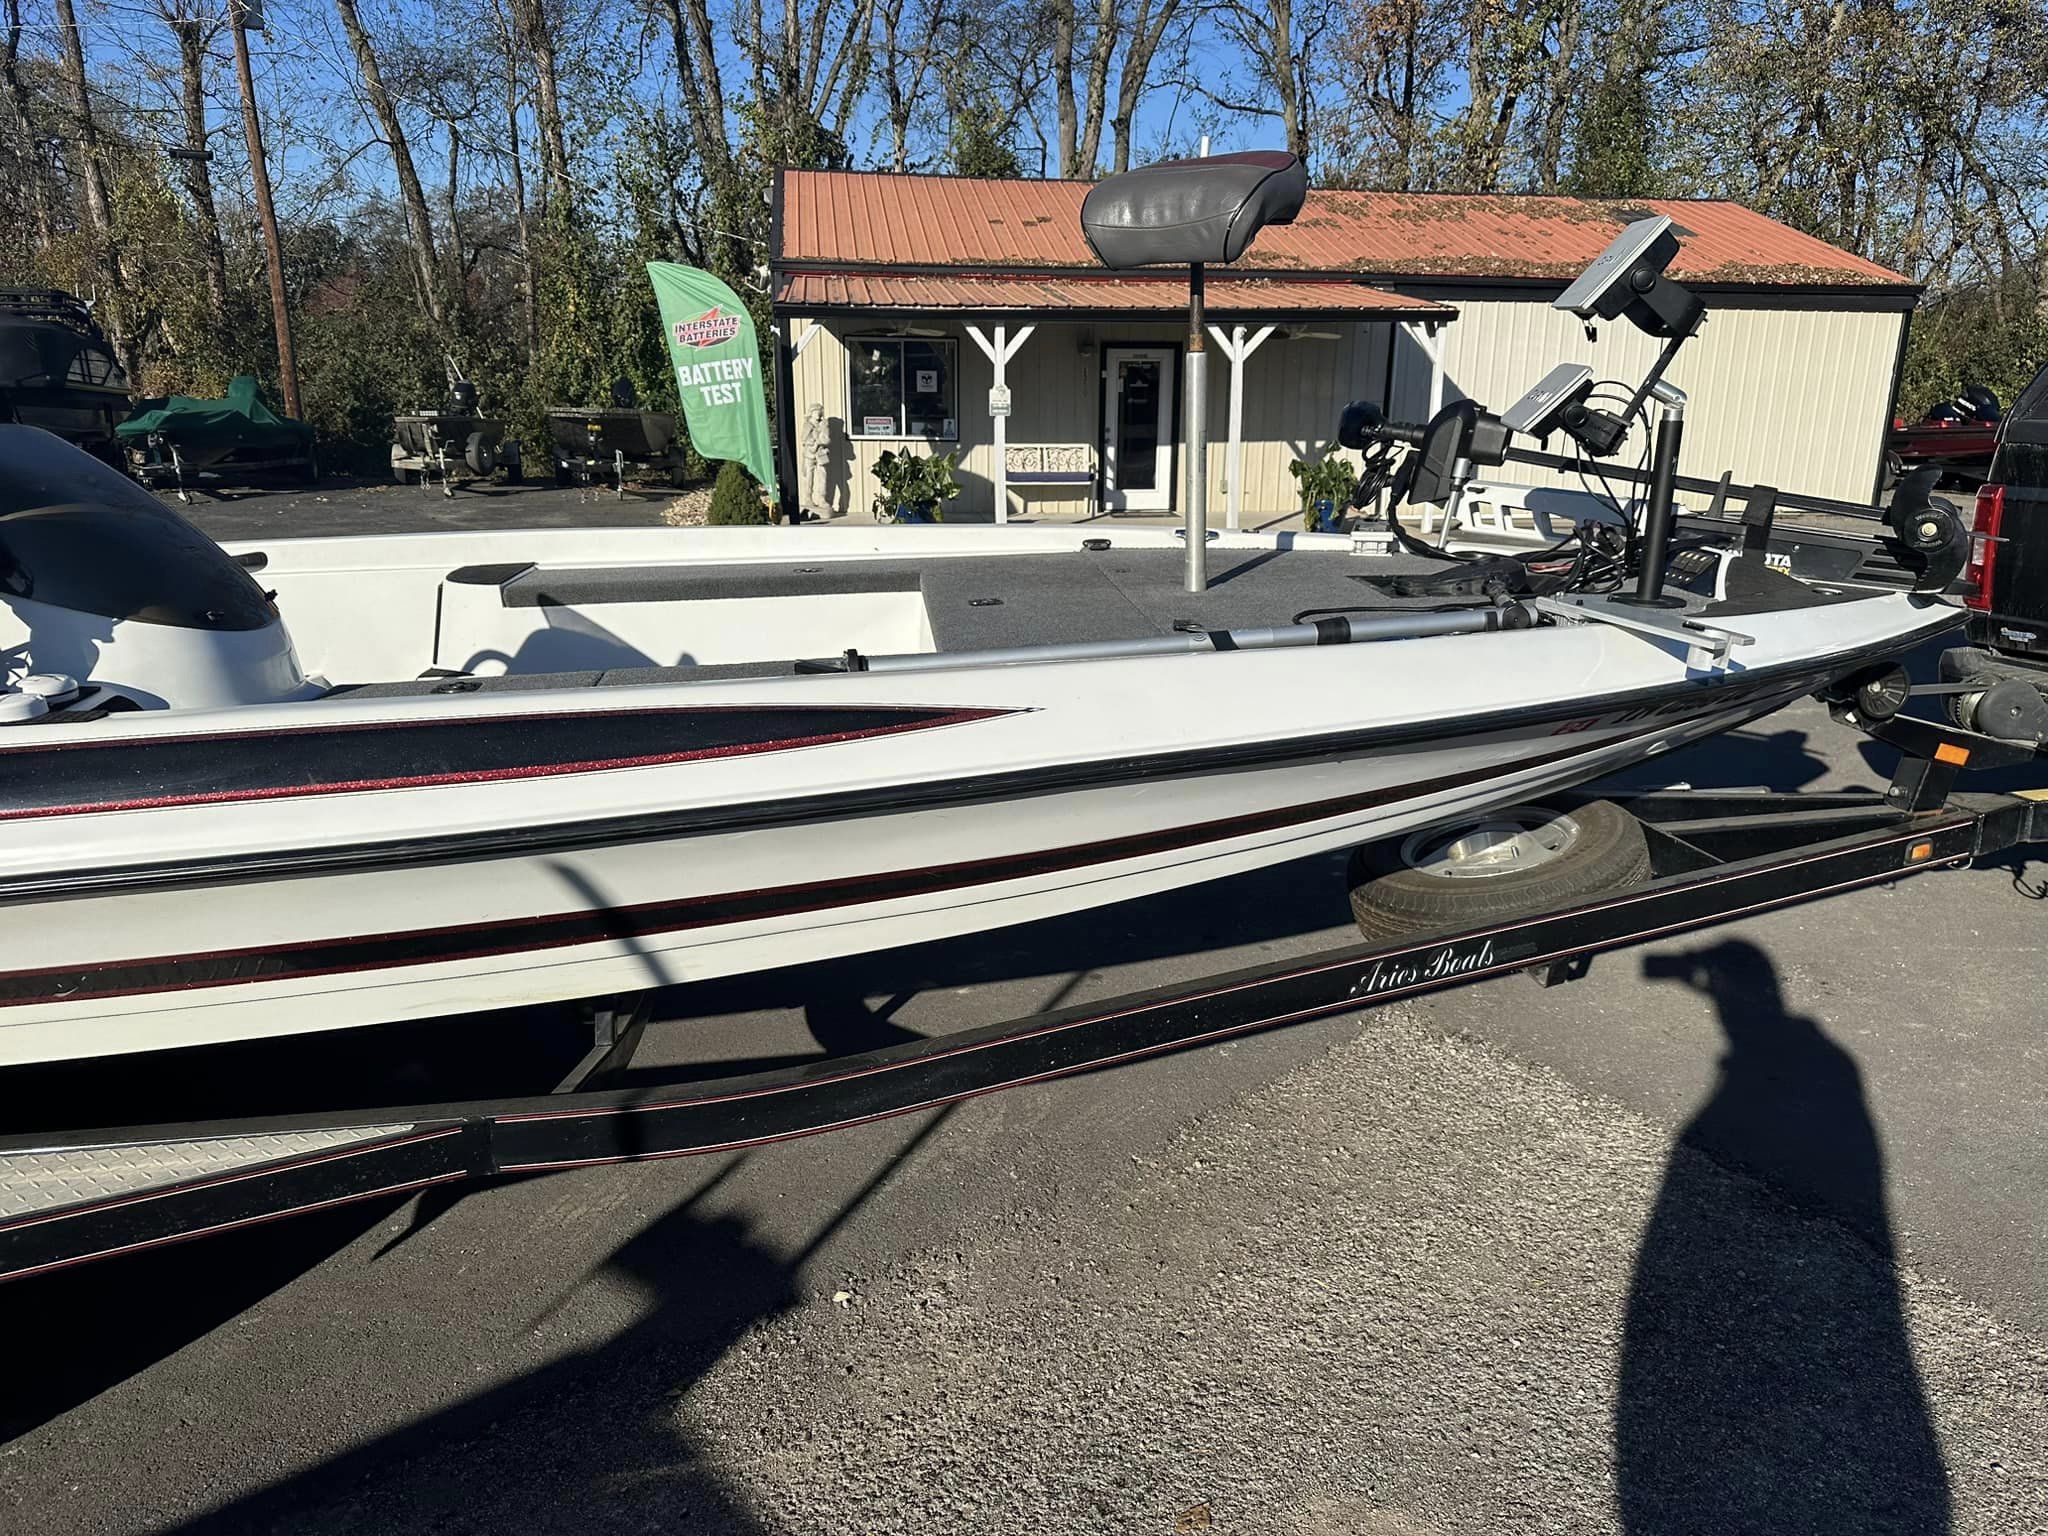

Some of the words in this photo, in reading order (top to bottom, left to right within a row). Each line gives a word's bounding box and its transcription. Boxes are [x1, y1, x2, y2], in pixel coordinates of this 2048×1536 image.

[674, 316, 739, 334] INTERSTATE
[679, 327, 737, 344] BATTERIES
[678, 357, 753, 387] BATTERY
[700, 382, 742, 407] TEST
